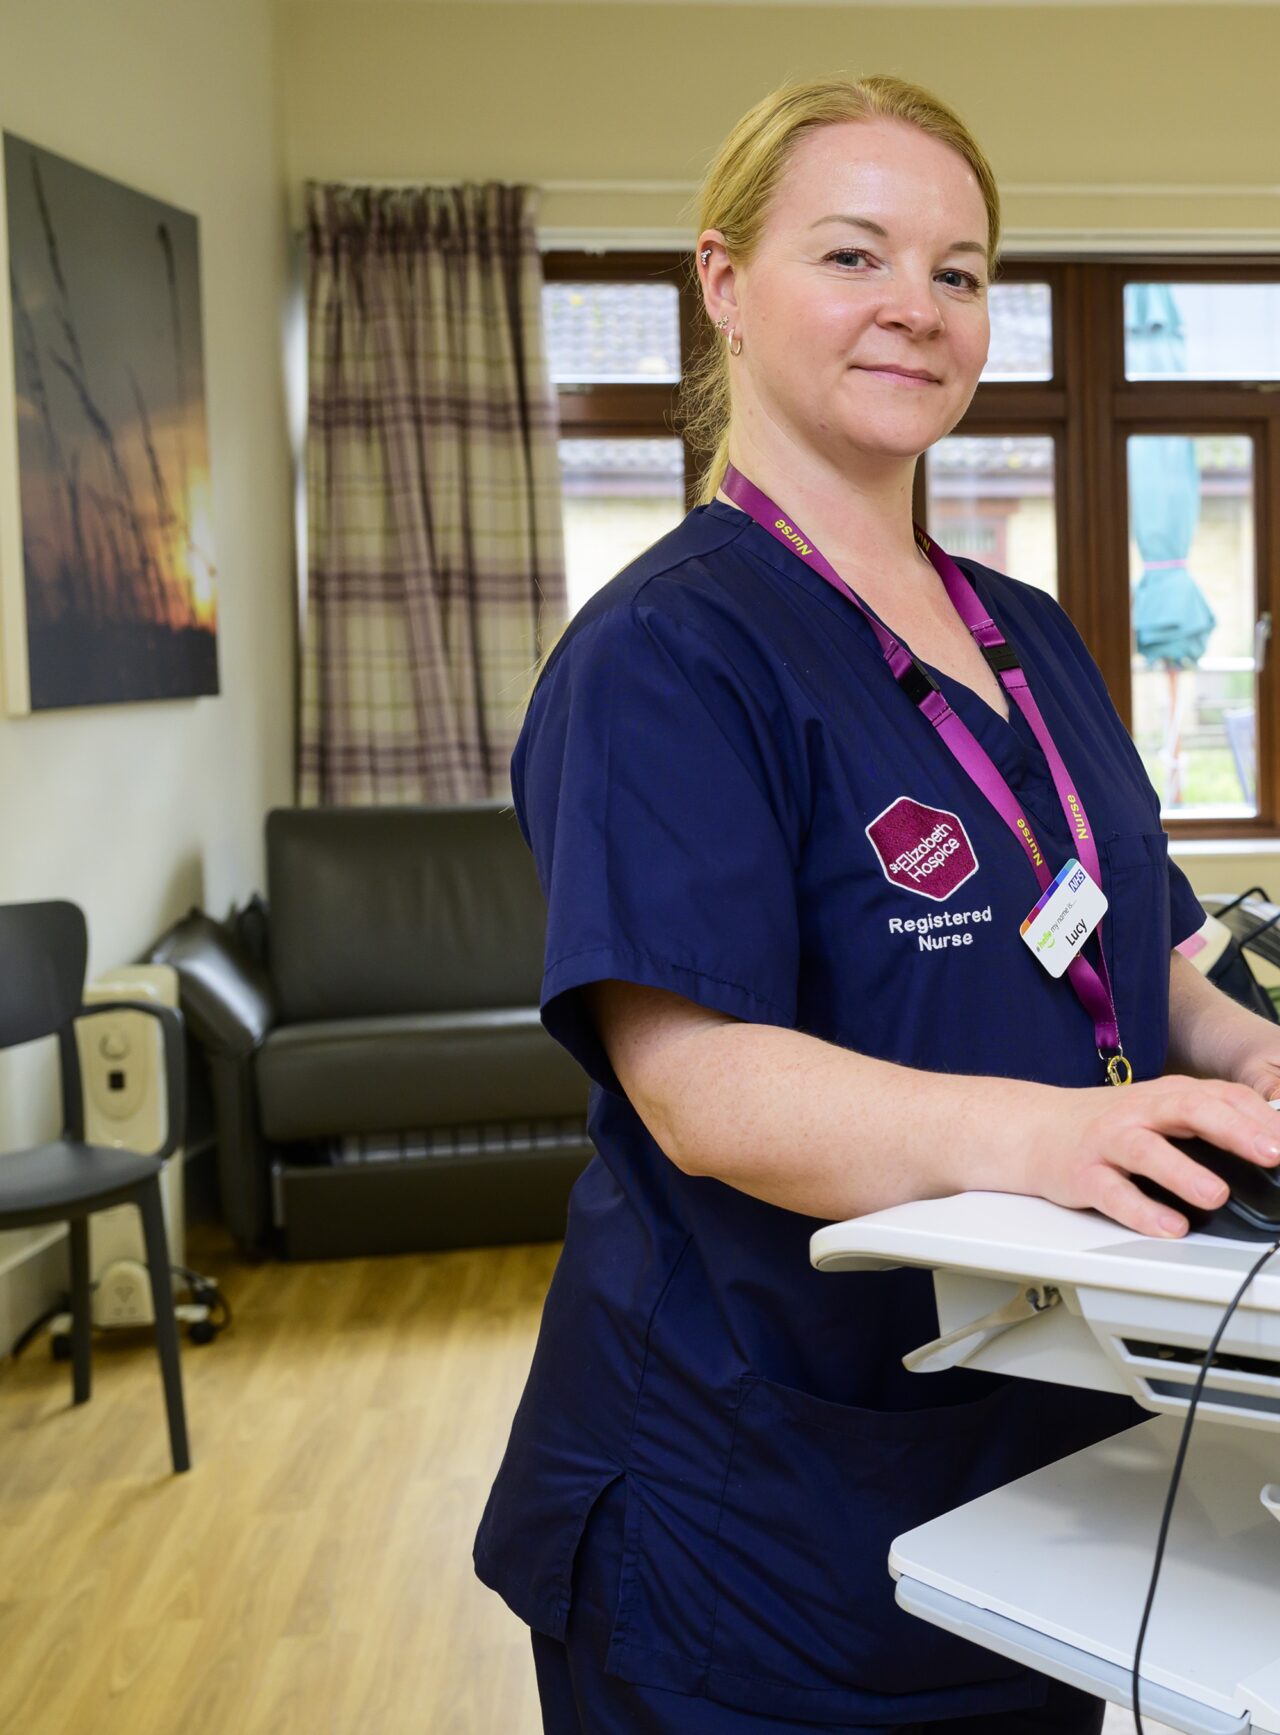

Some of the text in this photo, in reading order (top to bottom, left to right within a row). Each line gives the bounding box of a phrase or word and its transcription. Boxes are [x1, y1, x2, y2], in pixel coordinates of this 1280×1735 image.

[774, 519, 813, 556] Nurse
[1067, 794, 1089, 840] Nurse
[896, 823, 953, 872] Elizabeth
[1016, 818, 1043, 867] Nurse
[907, 838, 961, 883] Hospice
[1068, 869, 1086, 893] NHS
[888, 905, 993, 934] Registered
[1050, 923, 1060, 934] my
[1057, 907, 1071, 925] name
[1065, 918, 1088, 946] Lucy
[918, 932, 974, 952] Nurse
